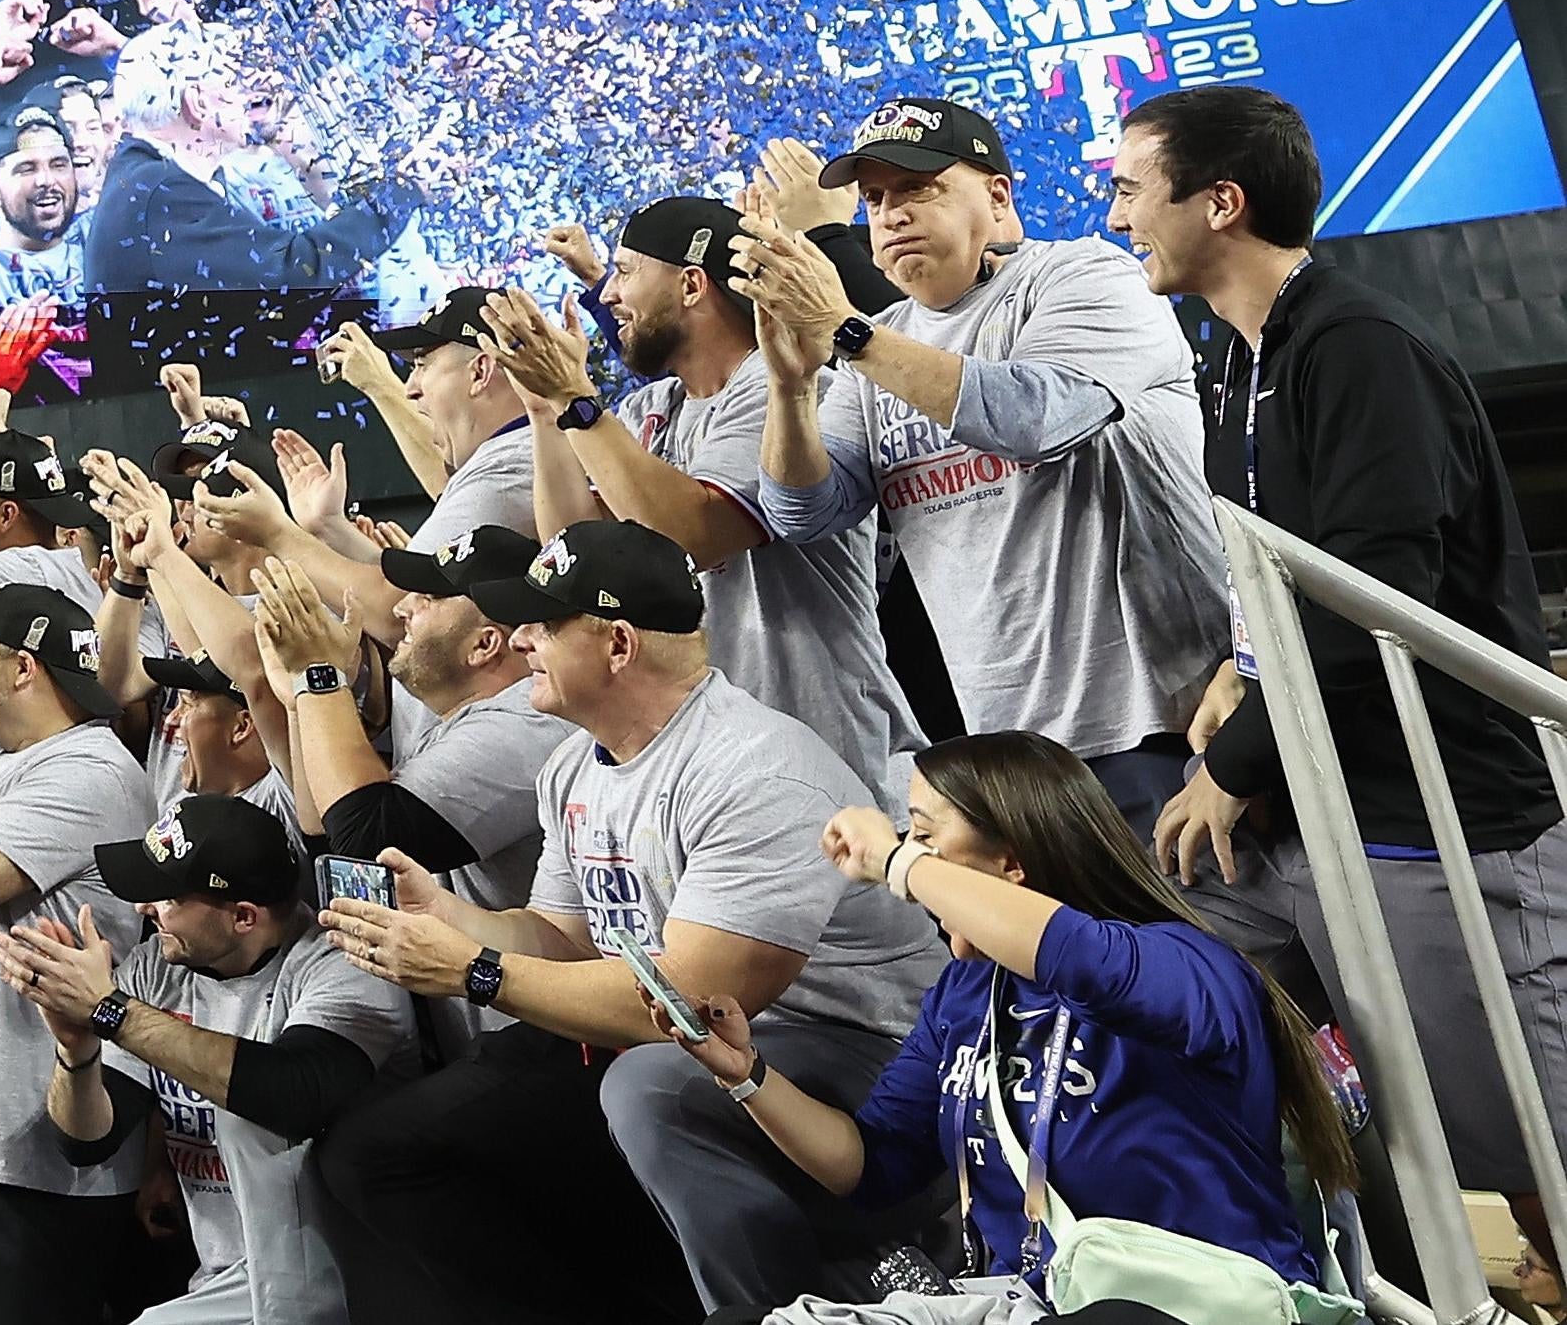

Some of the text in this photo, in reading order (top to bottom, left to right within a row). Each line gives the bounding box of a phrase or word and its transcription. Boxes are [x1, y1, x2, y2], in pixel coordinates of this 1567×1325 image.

[945, 32, 1263, 104] 20 23
[923, 499, 952, 515] TEXAS
